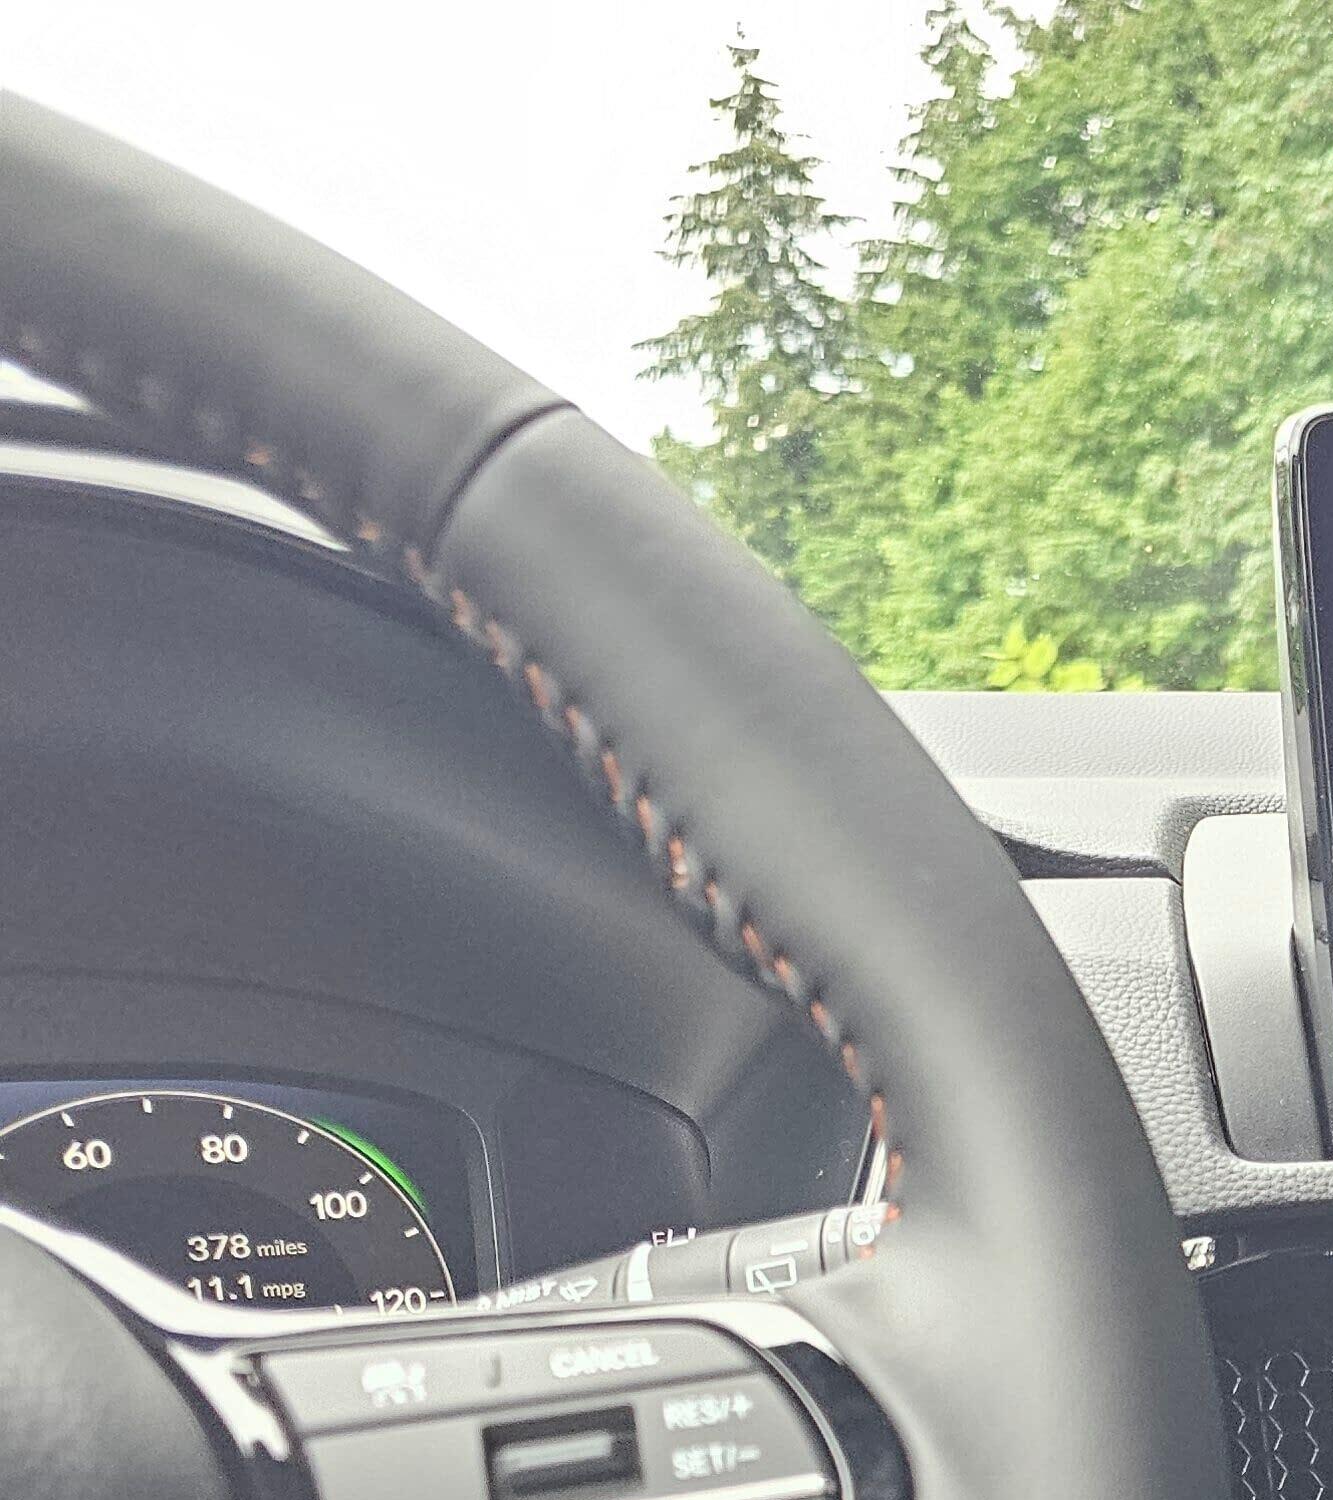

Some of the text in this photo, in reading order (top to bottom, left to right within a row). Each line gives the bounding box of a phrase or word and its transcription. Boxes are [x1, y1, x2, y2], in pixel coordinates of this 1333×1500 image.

[63, 1140, 112, 1170] 60
[201, 1134, 248, 1164] 80
[309, 1190, 368, 1220] 100
[186, 1233, 309, 1262] 378 miles
[186, 1272, 307, 1301] 11.1 mpg
[369, 1288, 428, 1317] 120
[548, 1342, 660, 1379] CANCEL
